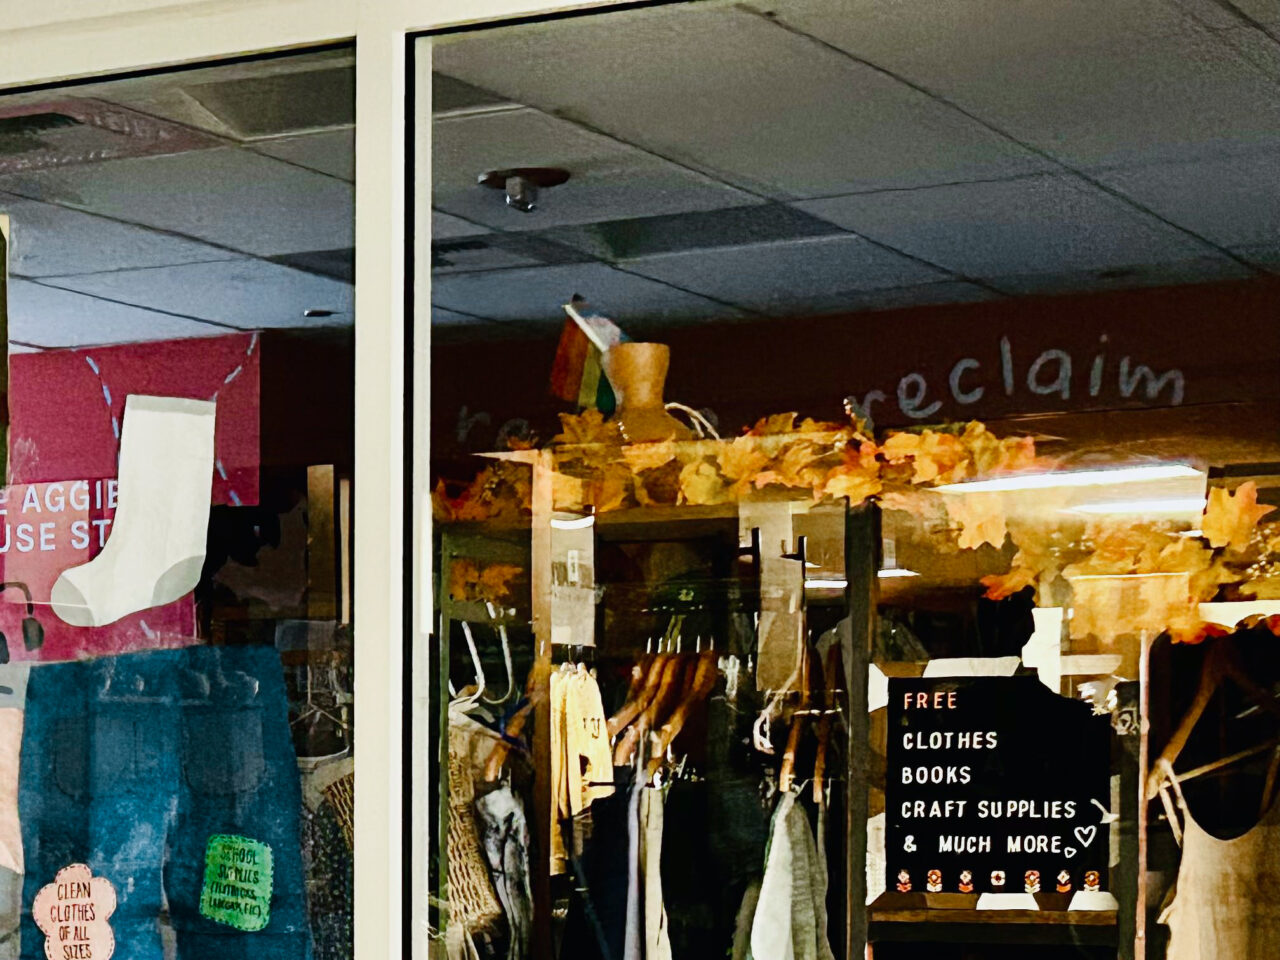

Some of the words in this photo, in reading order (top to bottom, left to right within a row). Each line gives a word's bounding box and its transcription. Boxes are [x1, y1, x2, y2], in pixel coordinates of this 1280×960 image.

[849, 333, 1185, 429] reclaim
[21, 479, 118, 514] AGGIE
[70, 519, 112, 550] ST
[903, 691, 958, 710] FREE
[902, 731, 998, 750] CLOTHES
[901, 766, 971, 785] BOOKS
[901, 800, 967, 819] CRAFT
[977, 800, 1077, 819] SUPPLIES
[903, 835, 917, 853] &
[938, 835, 992, 854] MUCH
[1007, 835, 1062, 854] MORE
[57, 881, 91, 901] CLEAN
[50, 903, 96, 922] CLOTHES
[59, 925, 70, 942] OF
[74, 926, 90, 941] ALL
[63, 943, 92, 960] SIZES
